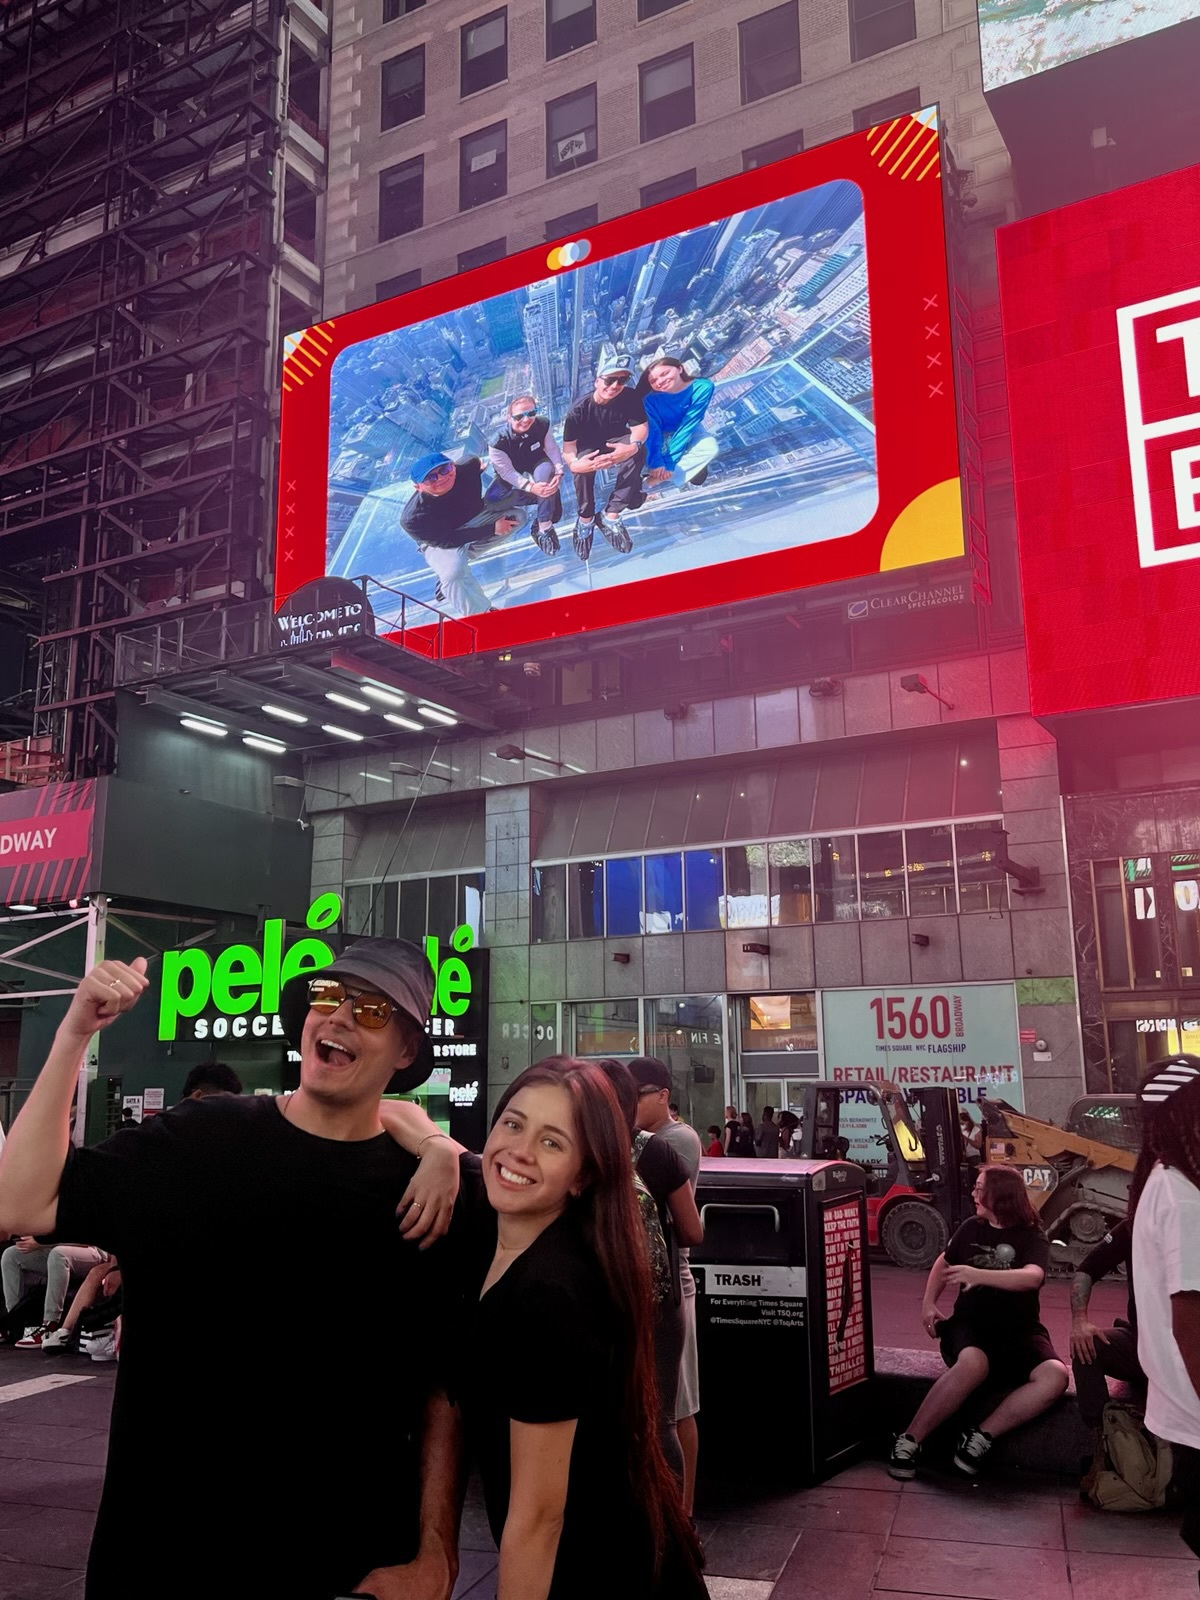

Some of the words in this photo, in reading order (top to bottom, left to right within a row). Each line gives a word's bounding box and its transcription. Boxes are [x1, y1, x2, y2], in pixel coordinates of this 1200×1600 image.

[908, 594, 964, 609] SPECTACOLOR
[278, 607, 343, 631] WELCOME
[344, 603, 362, 617] TO
[0, 827, 57, 855] DWAY
[158, 892, 341, 1041] pelé
[870, 995, 950, 1040] 1560
[953, 995, 965, 1038] BROADWAY
[425, 1018, 455, 1036] ER
[442, 1044, 477, 1057] STORE
[927, 1043, 967, 1054] FLAGSHIP
[449, 1081, 479, 1102] pelé
[839, 1088, 873, 1104] SPA
[1023, 1168, 1051, 1189] CAT
[824, 1221, 836, 1232] KEEP
[847, 1218, 860, 1228] FAITH
[826, 1255, 836, 1266] CAN
[714, 1273, 761, 1286] TRASH
[722, 1299, 757, 1307] Everything
[759, 1299, 778, 1307] Times
[779, 1300, 804, 1308] Square
[761, 1308, 776, 1316] Visit
[777, 1309, 804, 1318] TSQ.org
[710, 1317, 772, 1326] @TimesSquareNYC
[773, 1319, 804, 1327] @TsqArts
[829, 1354, 865, 1376] THRILLER
